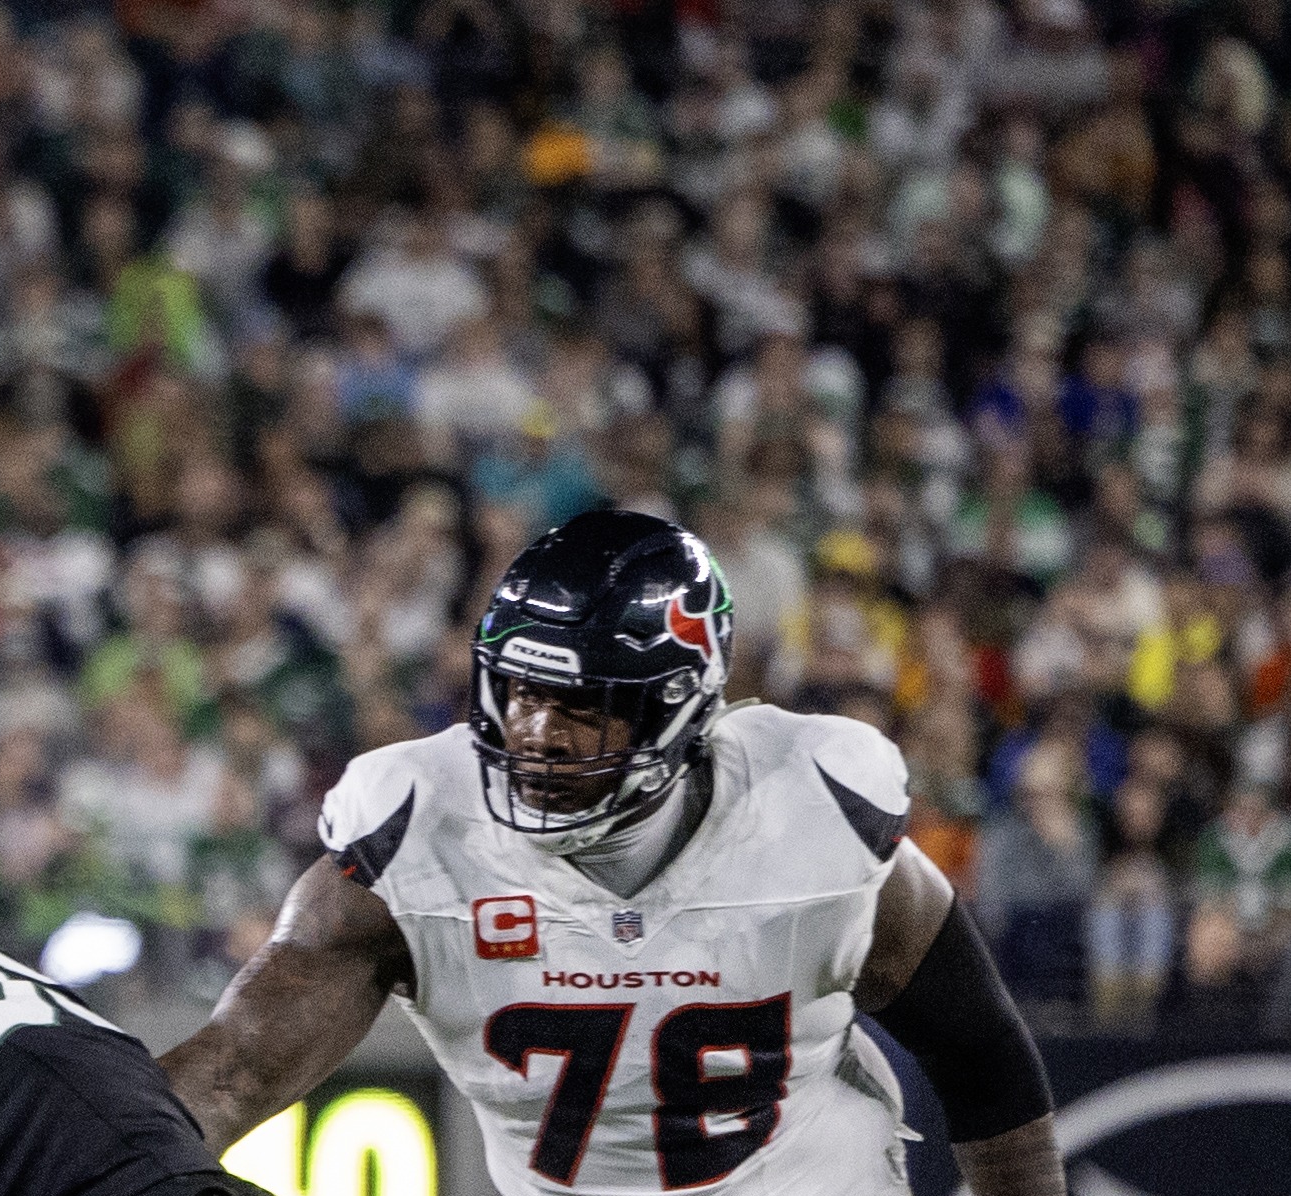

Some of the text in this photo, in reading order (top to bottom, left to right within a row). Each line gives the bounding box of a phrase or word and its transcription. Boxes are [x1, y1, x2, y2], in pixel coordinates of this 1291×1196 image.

[478, 900, 533, 943] C
[542, 970, 721, 989] HOUSTON
[484, 991, 792, 1191] 78
